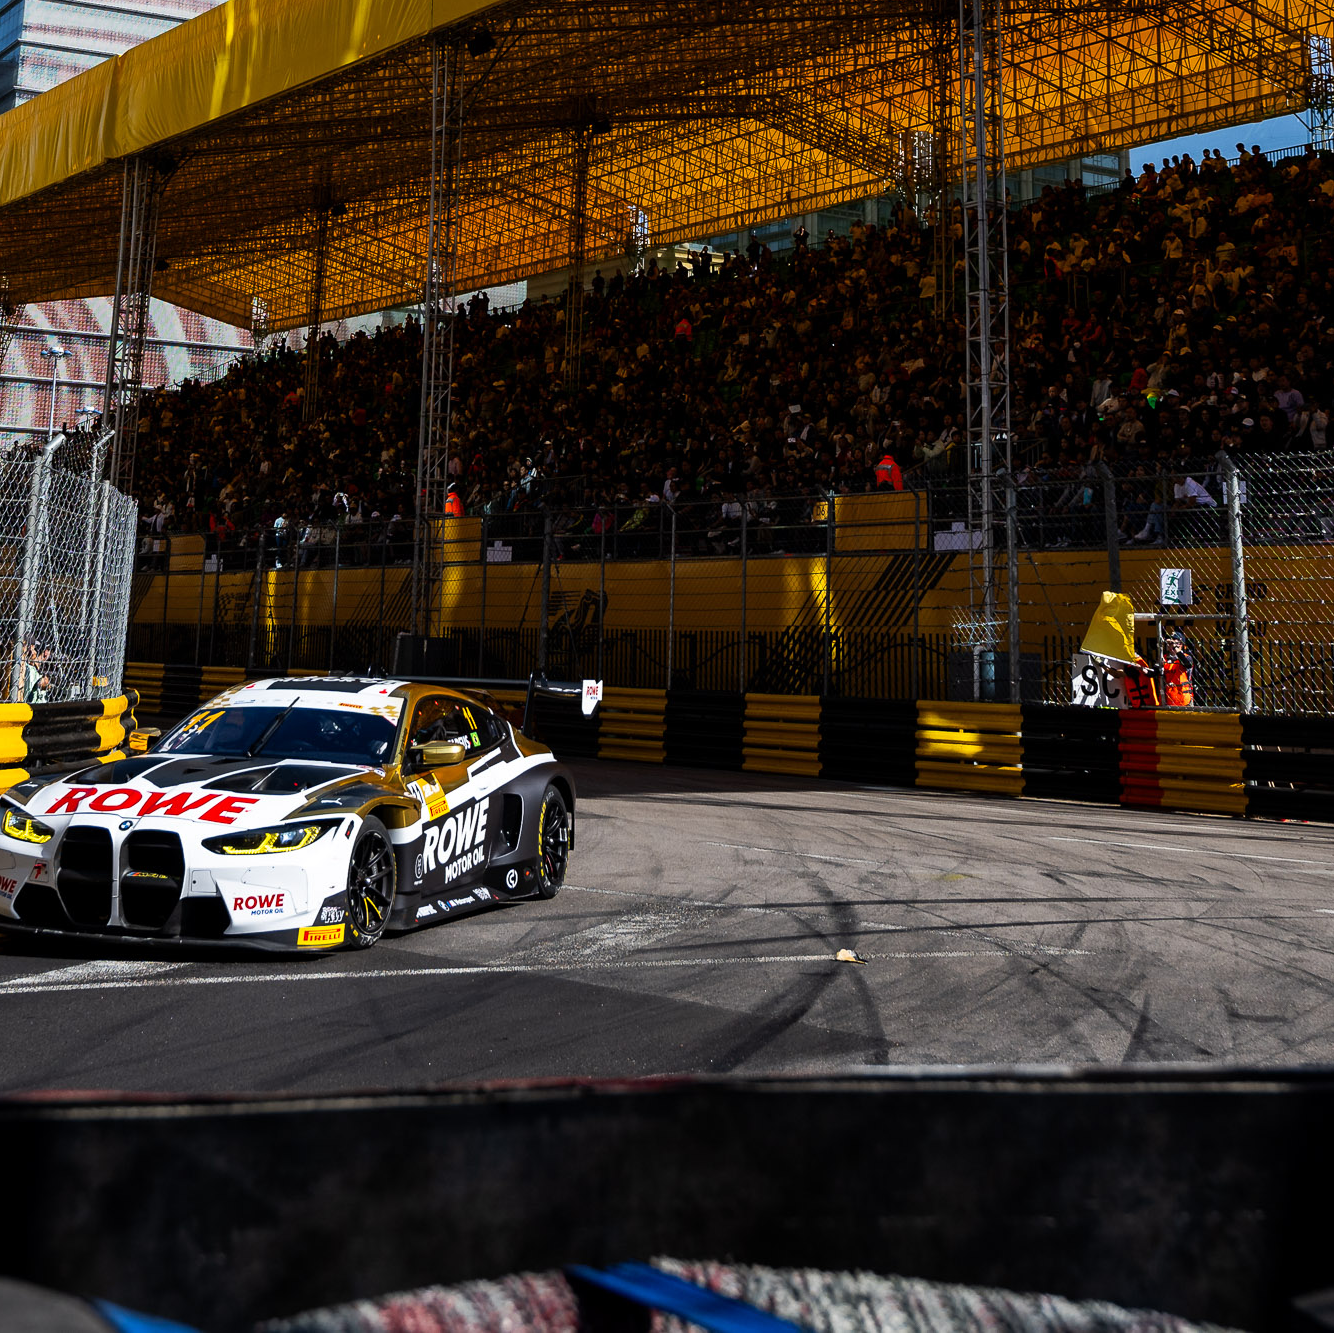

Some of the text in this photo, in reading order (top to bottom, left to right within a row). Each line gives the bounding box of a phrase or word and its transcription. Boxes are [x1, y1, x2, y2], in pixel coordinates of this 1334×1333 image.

[1164, 589, 1185, 597] EXIT
[1080, 665, 1121, 699] SC
[45, 787, 260, 825] ROWE
[423, 797, 490, 875] ROWE
[444, 844, 485, 884] MOTOR OIL
[233, 893, 285, 911] ROWE
[303, 927, 342, 942] PIRELLI
